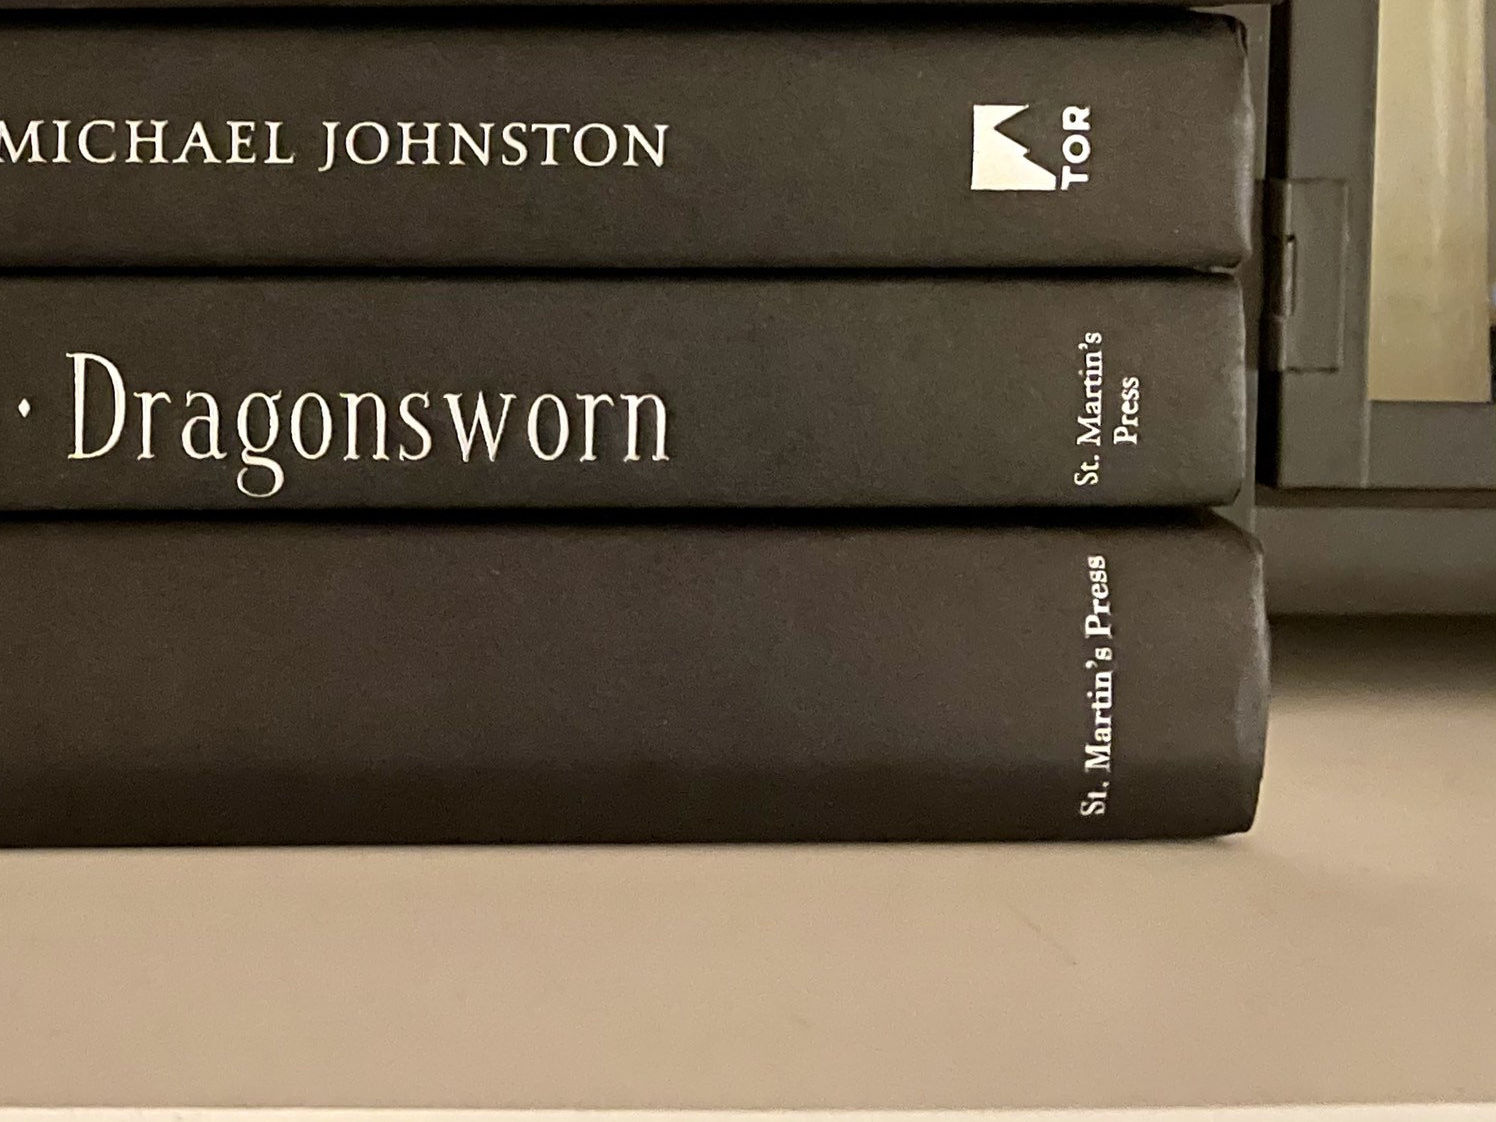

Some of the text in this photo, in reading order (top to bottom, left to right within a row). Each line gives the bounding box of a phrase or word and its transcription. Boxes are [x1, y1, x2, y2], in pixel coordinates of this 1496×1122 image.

[318, 121, 669, 172] JOHNSTON
[1061, 106, 1091, 190] TOR
[66, 353, 672, 497] Dragonsworn
[1073, 331, 1103, 486] St. Martin's
[1113, 376, 1140, 445] Press
[1079, 555, 1114, 817] St. Martin's Press
